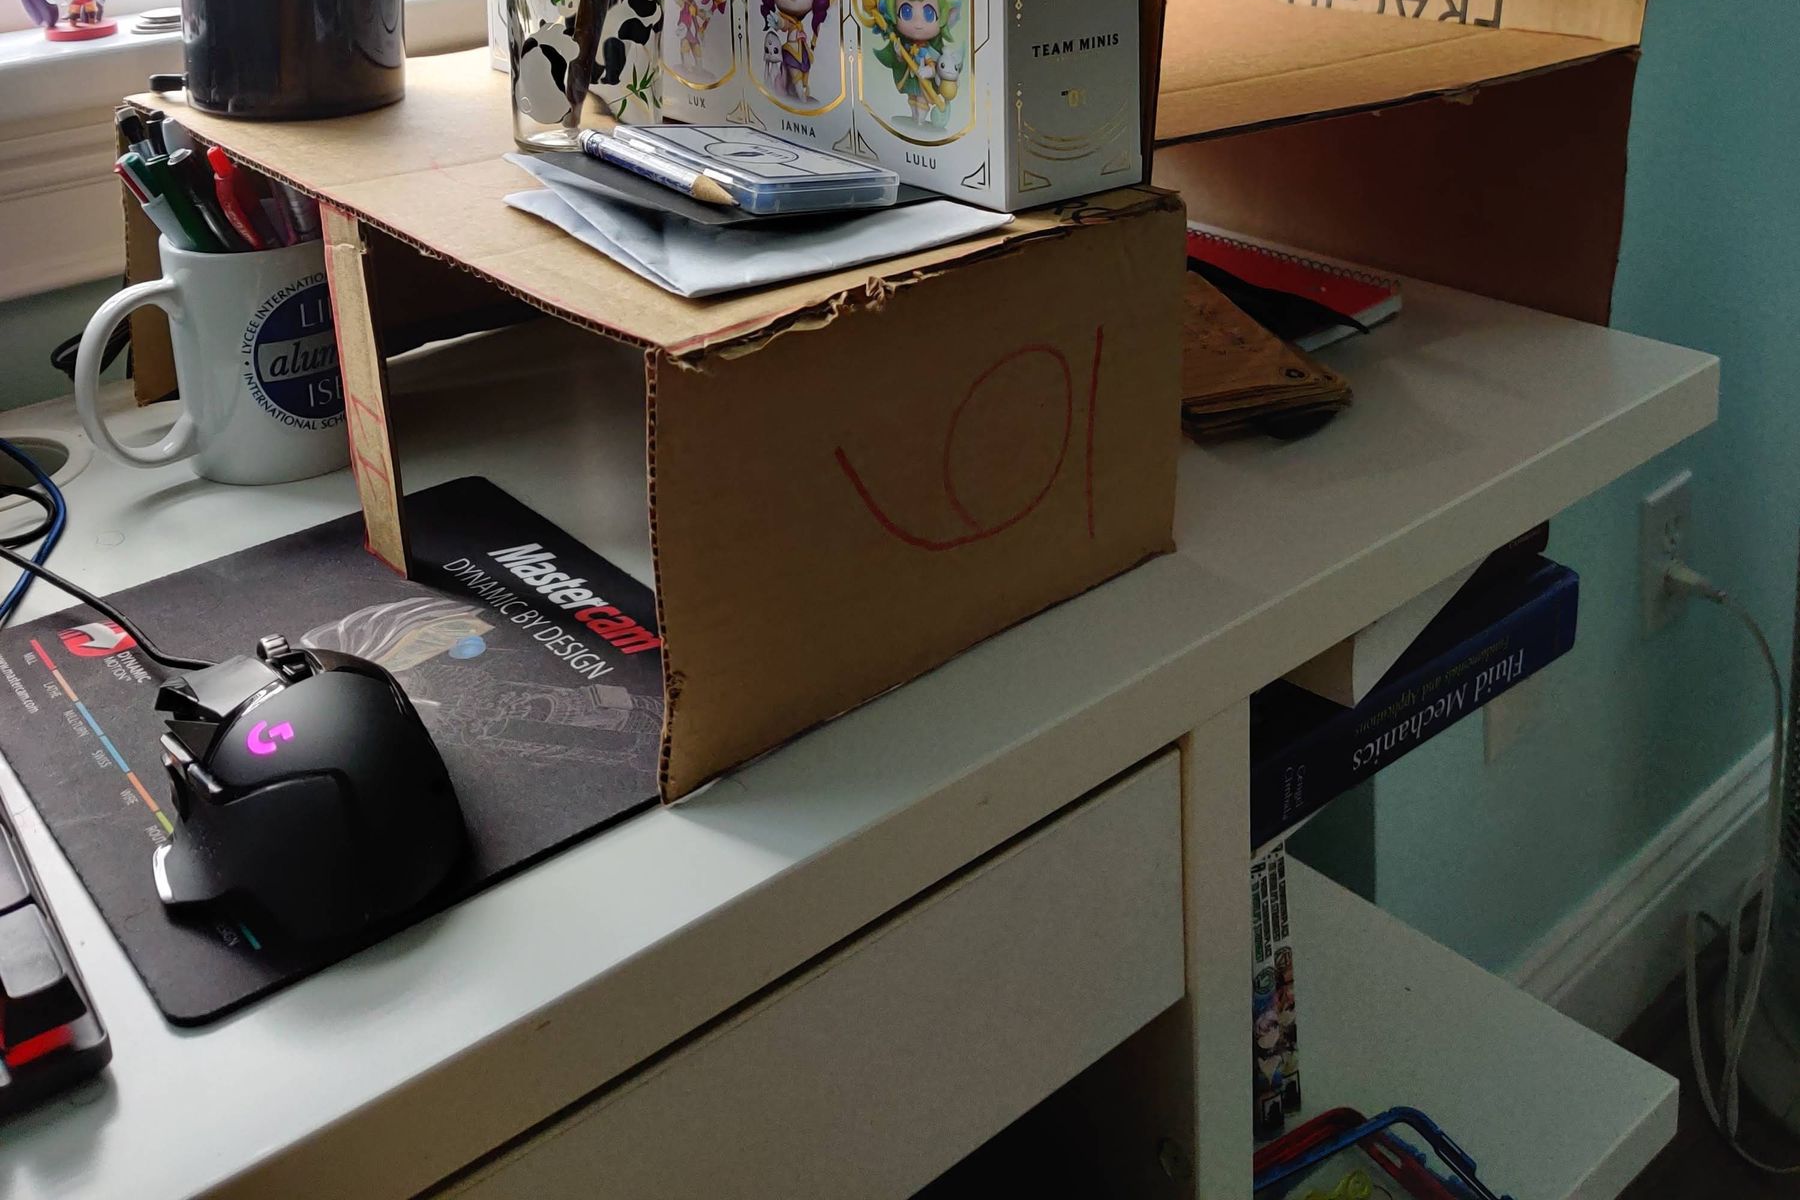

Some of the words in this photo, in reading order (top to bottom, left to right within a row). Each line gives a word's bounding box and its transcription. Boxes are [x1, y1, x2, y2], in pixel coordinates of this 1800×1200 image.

[1032, 40, 1073, 58] TEAM
[1079, 33, 1120, 51] MINIS
[688, 94, 707, 109] LUX
[905, 152, 938, 170] LULU
[242, 319, 259, 355] LYCEE
[255, 272, 328, 320] INTERNATIO
[300, 296, 332, 328] LI
[243, 372, 318, 431] INTERNATIONAL
[321, 414, 346, 430] SCH
[442, 558, 528, 615] DYNAMIC
[510, 609, 550, 630] BY
[533, 626, 615, 679] DESIGN
[487, 542, 662, 655] Mastercam
[116, 650, 152, 684] DYNAMIC
[1474, 648, 1525, 696] Fluid
[1352, 686, 1470, 772] Mechanics
[91, 749, 112, 768] SWISS
